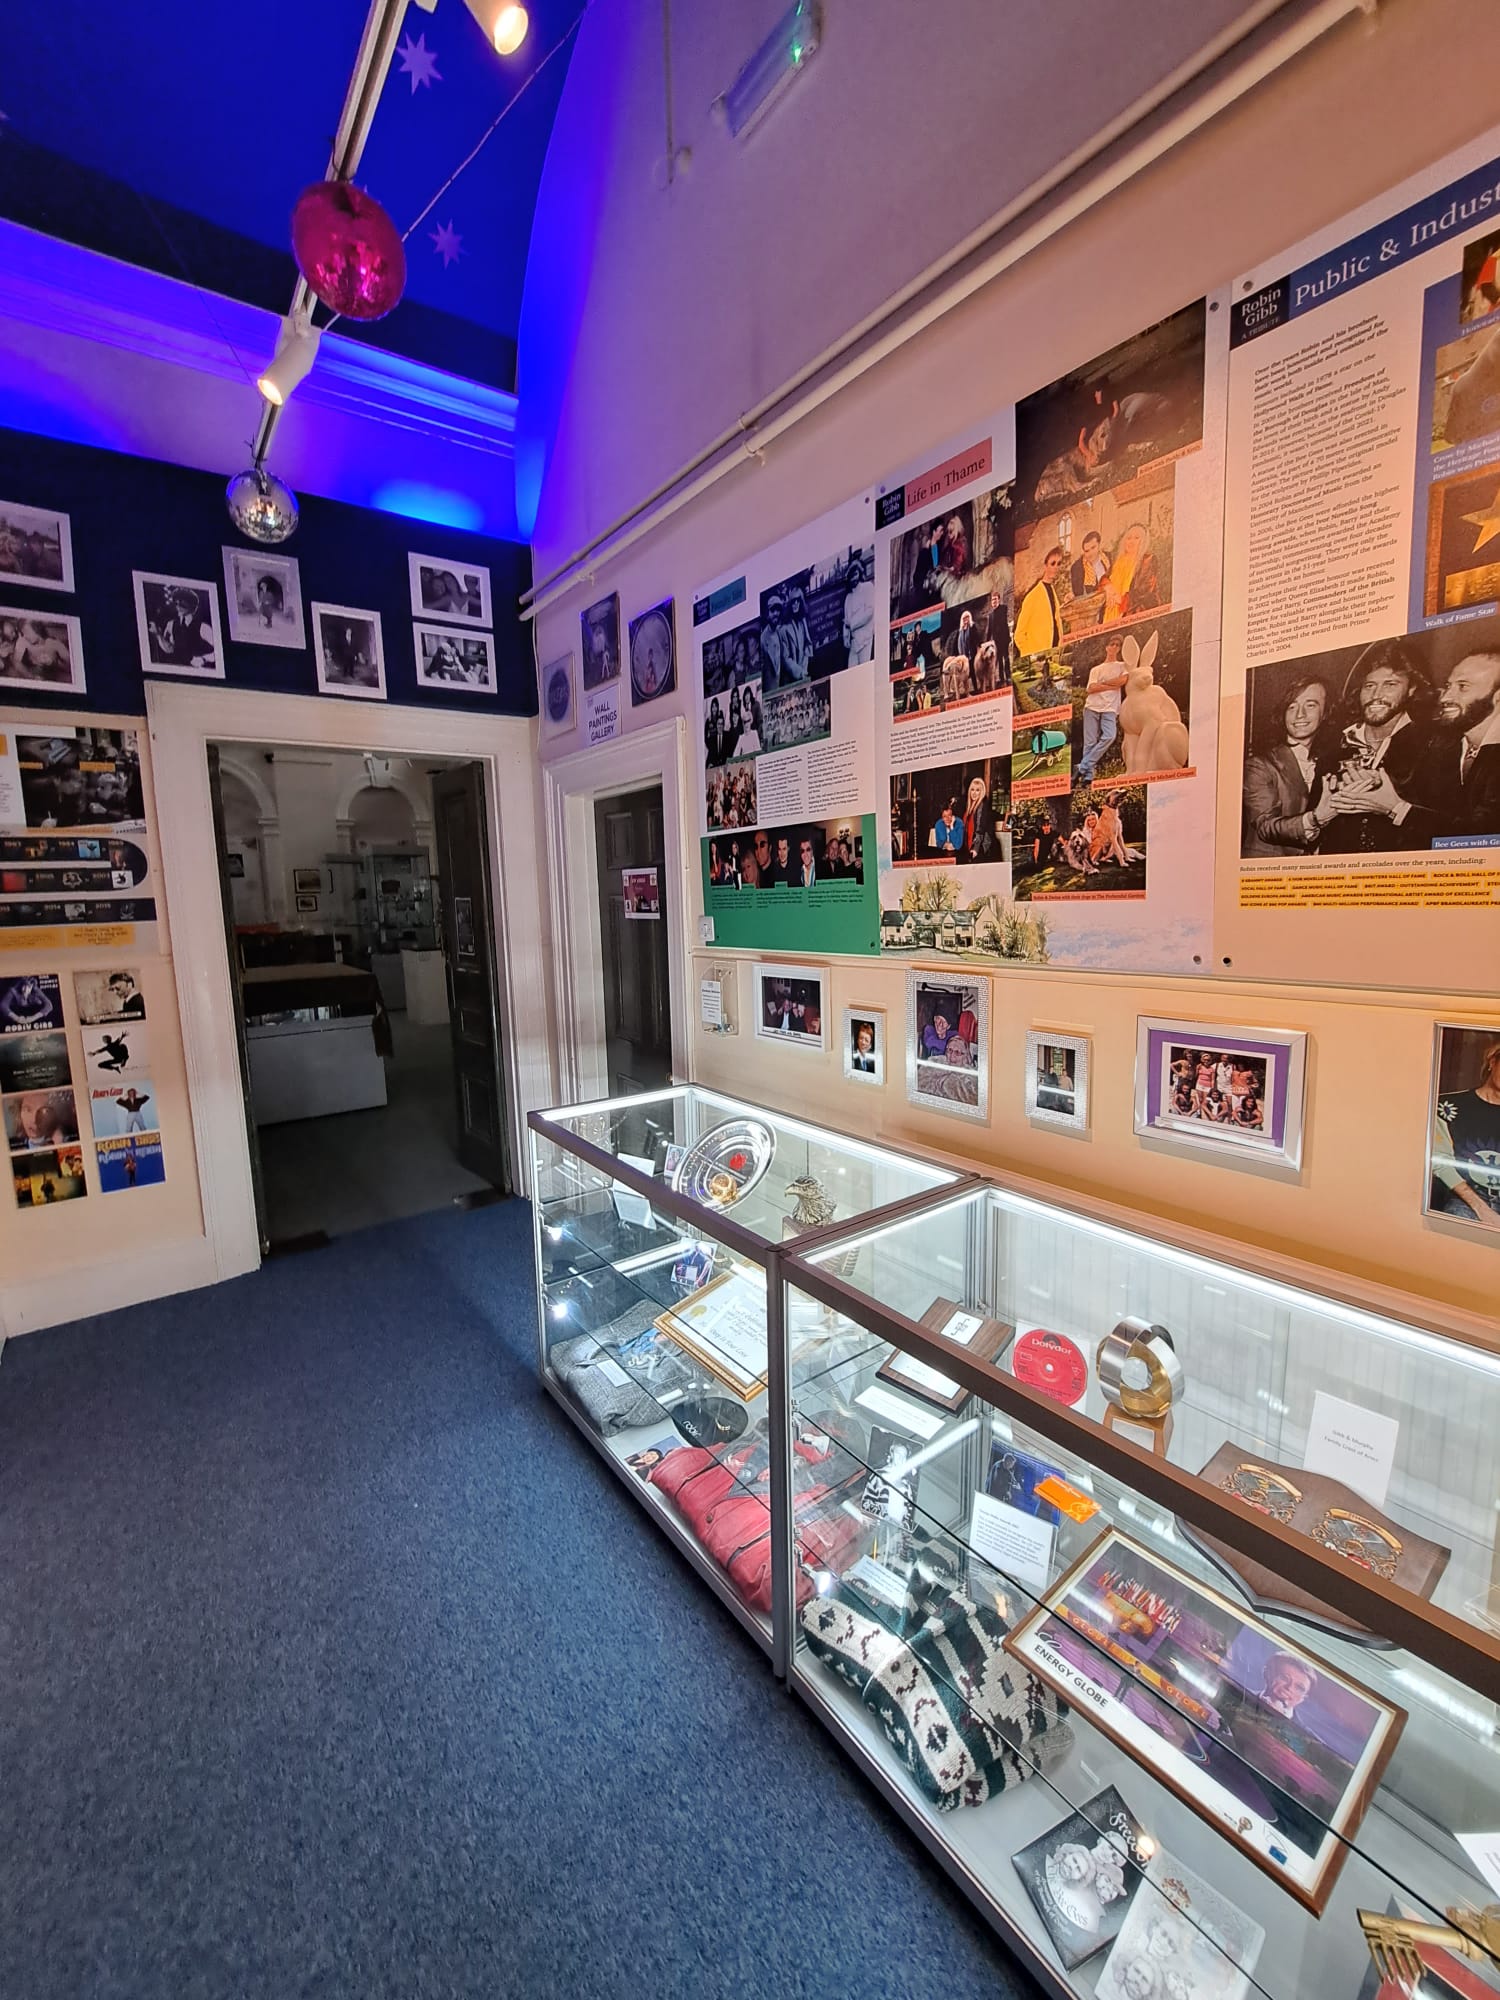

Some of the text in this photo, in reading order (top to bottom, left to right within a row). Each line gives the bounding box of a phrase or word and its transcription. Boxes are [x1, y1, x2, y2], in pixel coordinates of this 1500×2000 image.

[1295, 255, 1371, 307] Public
[1380, 239, 1400, 262] &
[1241, 289, 1281, 316] Robin
[1244, 304, 1278, 327] Gibb
[1241, 317, 1280, 341] A TRIBUTE
[907, 457, 985, 507] Life in Thame
[882, 492, 902, 509] Robin
[884, 502, 900, 517] Gibb
[1425, 607, 1496, 628] Walk of Fame Star
[594, 702, 611, 714] WALL
[588, 710, 618, 729] PAINTINGS
[590, 723, 615, 741] GALLERY
[1448, 857, 1486, 865] including:
[1031, 1338, 1073, 1355] Polydor
[1034, 1645, 1109, 1708] ENERGY GLOBE
